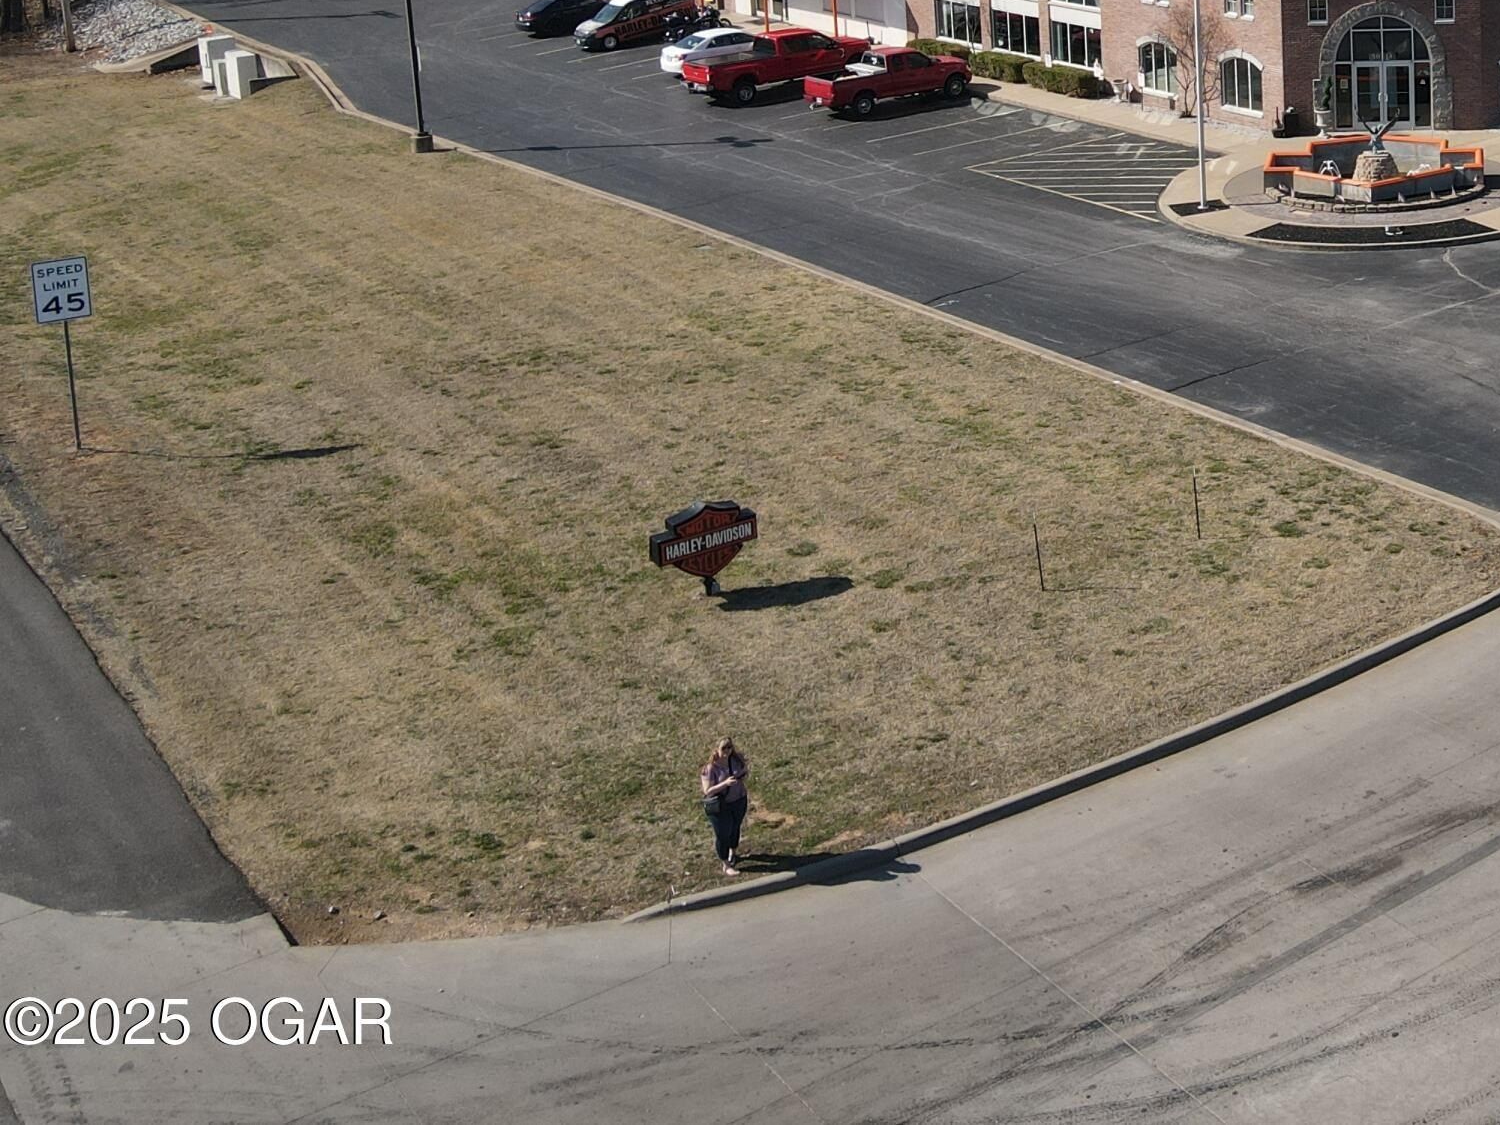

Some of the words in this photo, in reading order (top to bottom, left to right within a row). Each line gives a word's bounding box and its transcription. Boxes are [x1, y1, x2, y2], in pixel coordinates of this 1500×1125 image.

[36, 263, 83, 279] SPEED
[43, 278, 79, 292] LIMIT
[42, 292, 85, 315] 45
[665, 521, 753, 561] HARLEY-DAVIDSON
